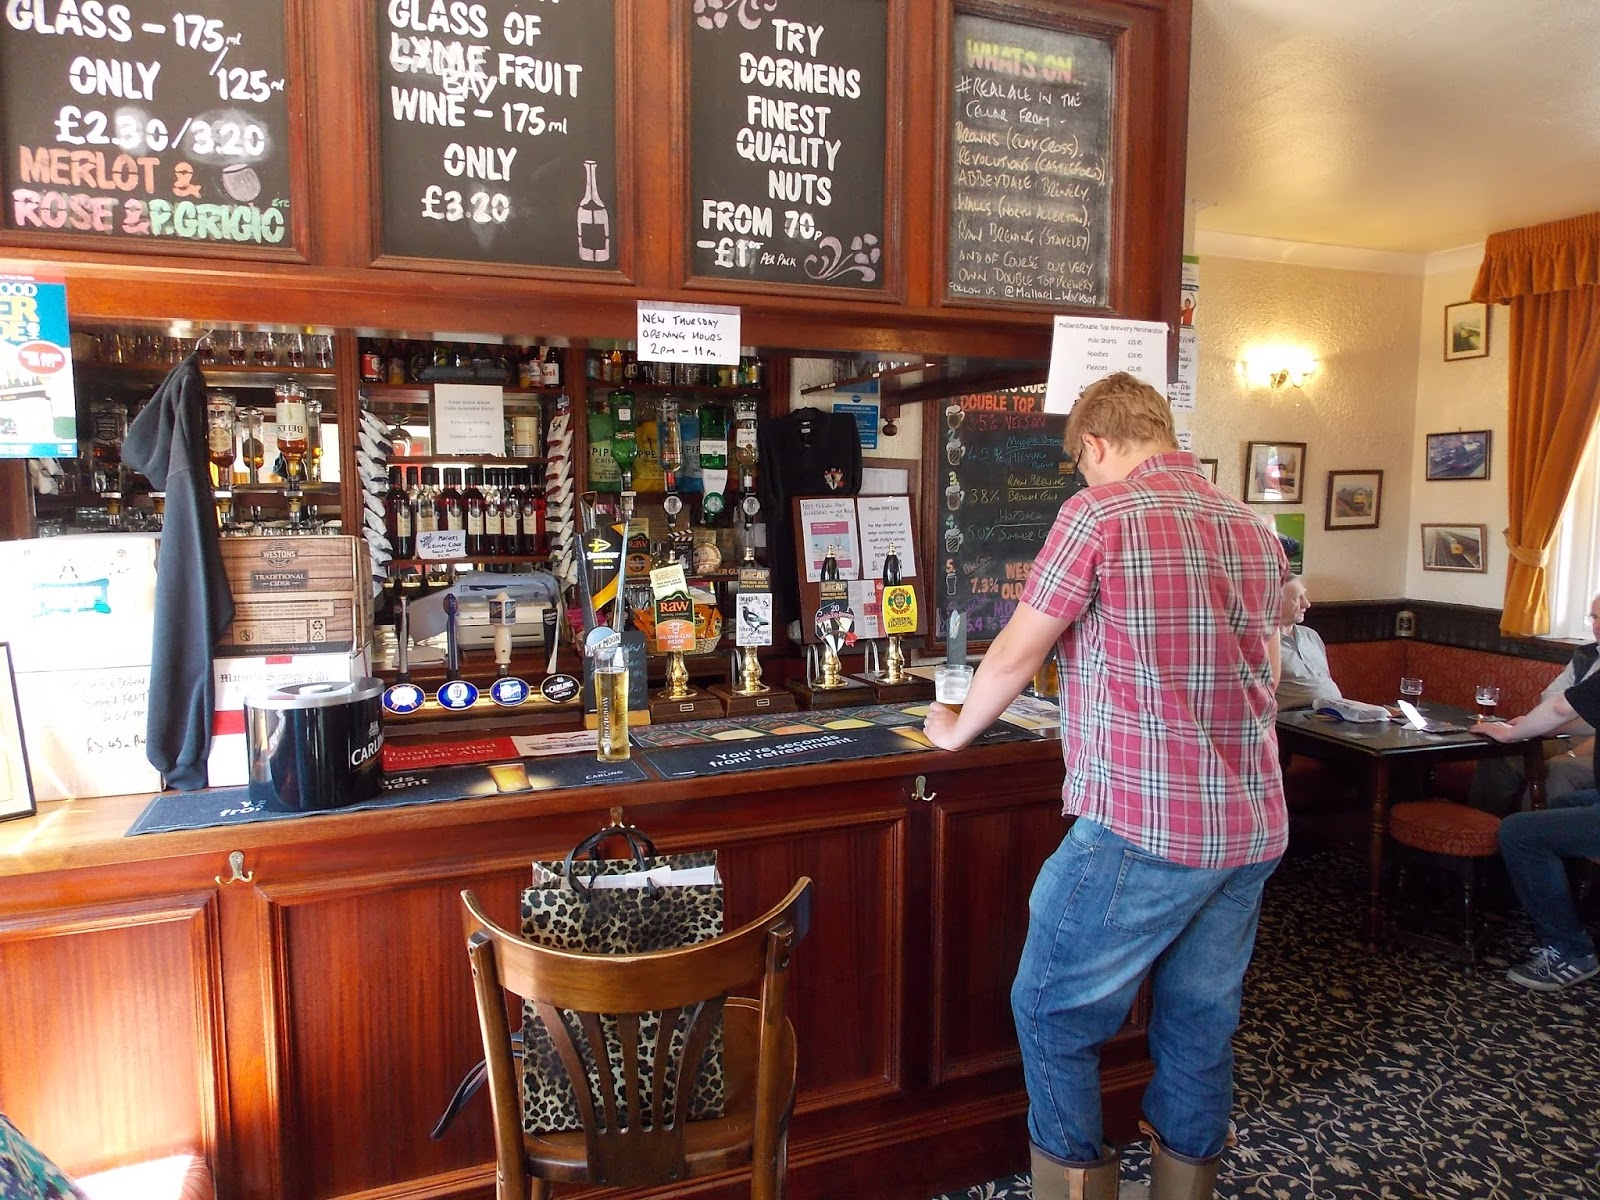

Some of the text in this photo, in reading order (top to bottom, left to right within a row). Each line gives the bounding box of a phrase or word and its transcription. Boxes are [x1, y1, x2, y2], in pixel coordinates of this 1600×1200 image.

[6, 0, 132, 42] GLASS
[388, 0, 542, 46] GLASS OF
[772, 19, 824, 57] TRY
[966, 39, 1037, 79] WHATS
[69, 56, 161, 100] ONLY
[498, 53, 583, 98] FRUIT
[739, 52, 861, 99] DORMENS
[391, 86, 466, 127] WINE
[966, 100, 1009, 123] CELLAR
[1039, 92, 1052, 105] IN
[1061, 92, 1082, 107] THE
[747, 95, 831, 137] FINEST
[443, 143, 517, 181] ONLY
[736, 127, 842, 171] QUALITY
[19, 145, 160, 193] MERLOT
[957, 169, 1032, 190] ABBEYDALE
[768, 170, 832, 206] NUTS
[12, 188, 115, 234] ROSE
[702, 200, 773, 238] FROM
[959, 250, 982, 264] AND
[985, 252, 999, 264] OF
[1003, 251, 1039, 270] COURSE
[1068, 260, 1093, 276] VERY
[948, 281, 981, 295] FOLLOW
[985, 287, 996, 296] US
[959, 268, 987, 282] OWN
[993, 268, 1033, 287] DOUBLE
[1037, 275, 1055, 288] TOP
[642, 313, 719, 329] NEW THURSDAY
[1110, 324, 1133, 333] Brewery
[642, 329, 722, 342] OPENING HOURS
[1100, 337, 1117, 345] Shirts
[960, 394, 1036, 412] DOUBLE TOP
[1004, 415, 1046, 431] NELSON
[548, 681, 575, 693] CARLING
[384, 742, 497, 756] Hand Crafted
[388, 748, 494, 762] English Ales
[716, 734, 841, 760] You're seconds
[709, 755, 751, 768] from
[585, 770, 624, 780] CARLING
